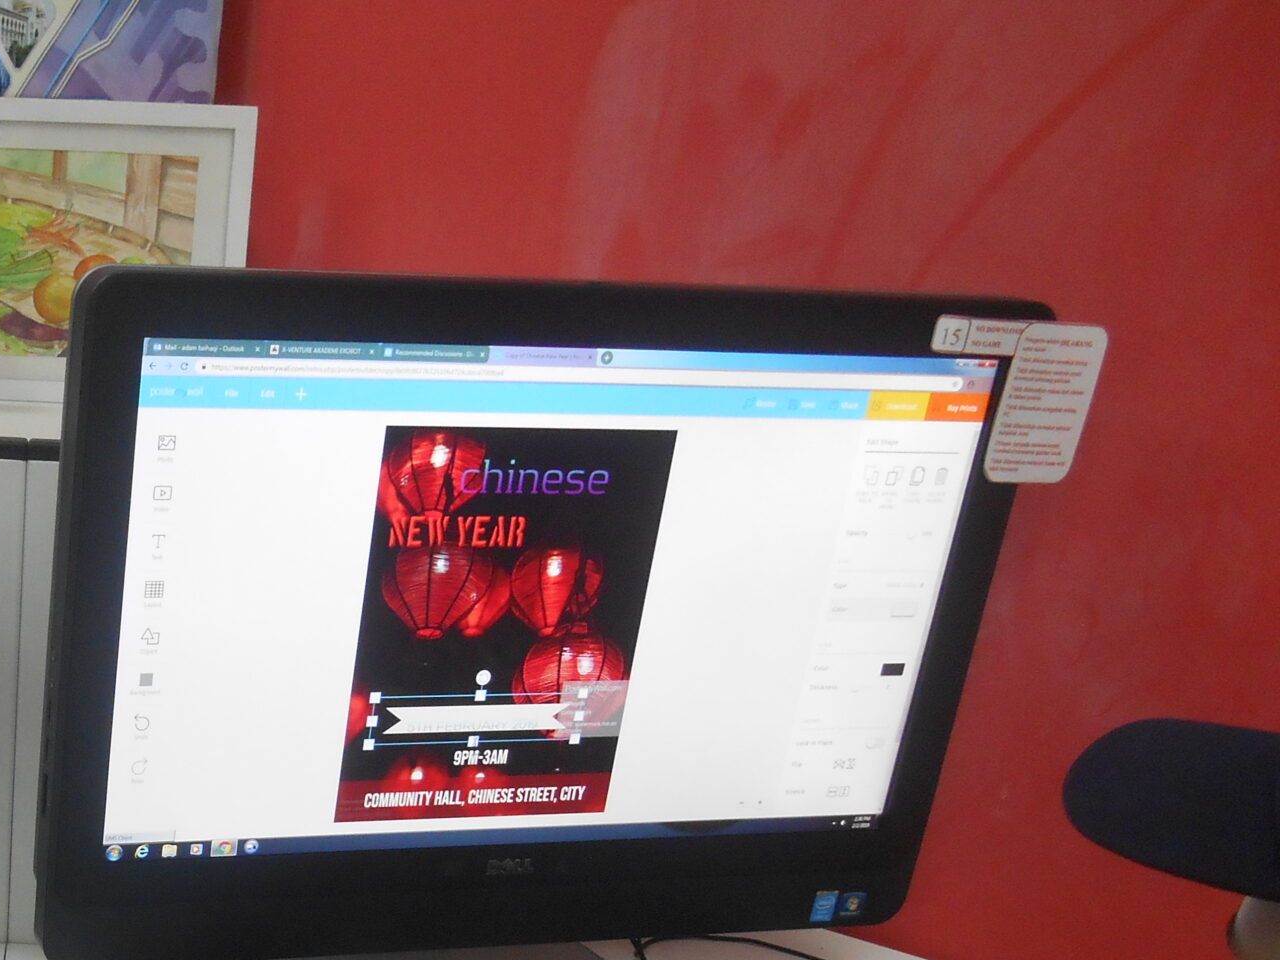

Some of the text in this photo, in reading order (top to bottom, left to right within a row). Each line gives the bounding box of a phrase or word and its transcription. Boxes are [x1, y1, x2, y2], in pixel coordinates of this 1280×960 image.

[941, 327, 962, 346] 15
[947, 404, 978, 413] Buy Prints
[459, 459, 610, 495] chinese
[388, 515, 527, 548] NEW YEAR
[436, 720, 508, 732] FEBRUARY
[453, 749, 509, 766] 9PM-3AM
[364, 785, 586, 808] COMMUNITY HALL, CHINESE STREET, CITY
